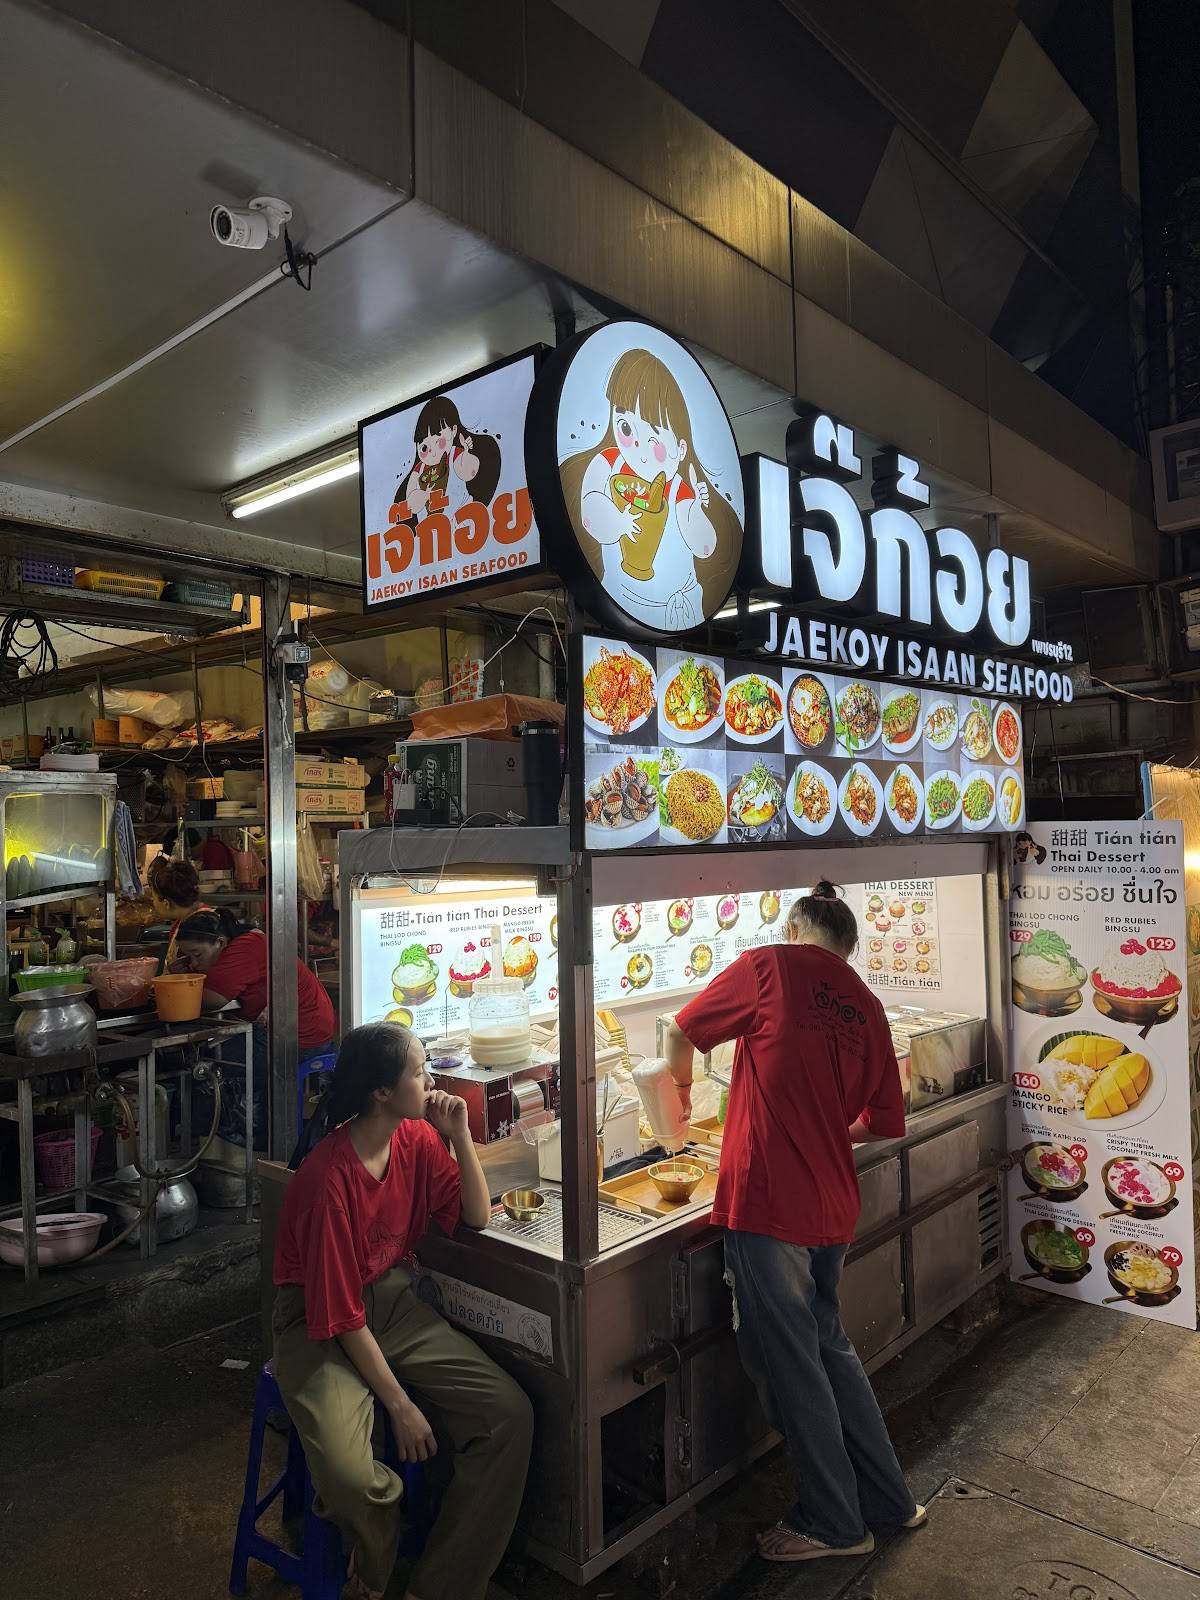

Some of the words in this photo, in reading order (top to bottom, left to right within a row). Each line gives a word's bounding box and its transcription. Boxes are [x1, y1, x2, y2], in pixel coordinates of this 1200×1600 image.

[367, 487, 533, 580] เจ๊ก้อย
[759, 415, 1031, 646] เจ๊ก้อย
[371, 579, 413, 601] JAEKOY
[418, 570, 458, 591] ISAAN
[462, 551, 528, 580] SEAFOOD
[764, 611, 890, 671] JAEKOY
[898, 640, 976, 686] ISAAN
[981, 659, 1074, 703] SEAFOOD
[1051, 829, 1088, 847] 甜甜
[1095, 831, 1133, 845] Tián
[1140, 830, 1177, 845] tián
[1051, 851, 1081, 862] Thai
[1087, 851, 1146, 863] Dessert
[1051, 865, 1075, 873] OPEN
[1078, 865, 1103, 873] DAILY
[1107, 866, 1132, 874] 10.00
[1140, 866, 1161, 874] 4.00
[864, 882, 887, 890] THAI
[890, 881, 934, 890] DESSERT
[1058, 880, 1115, 903] อร่อย
[1123, 875, 1178, 904] ชื่นใจ
[380, 910, 410, 929] 甜甜
[474, 908, 498, 919] Thai
[502, 903, 543, 916] Dessert
[1009, 911, 1027, 919] THAI
[1029, 912, 1045, 920] LOD
[1048, 913, 1080, 922] CHONG
[1105, 916, 1121, 924] RED
[1124, 917, 1157, 925] RUBIES
[1009, 920, 1040, 929] BINGSU
[1105, 925, 1141, 933] BINGSU
[1012, 931, 1031, 941] 129
[428, 945, 442, 953] 129
[1149, 938, 1174, 950] 129
[1014, 1074, 1039, 1088] 160
[1012, 1090, 1051, 1102] MANGO
[1012, 1100, 1045, 1112] STICKY
[1047, 1105, 1068, 1116] RICE
[1106, 1138, 1129, 1147] CRISPY
[1071, 1148, 1085, 1158] 69
[1106, 1145, 1139, 1155] COCONUT
[1141, 1150, 1160, 1158] FRESH
[1162, 1153, 1179, 1161] MILK
[1165, 1168, 1181, 1177] 69
[1076, 1231, 1092, 1241] 69
[1163, 1250, 1179, 1261] 79
